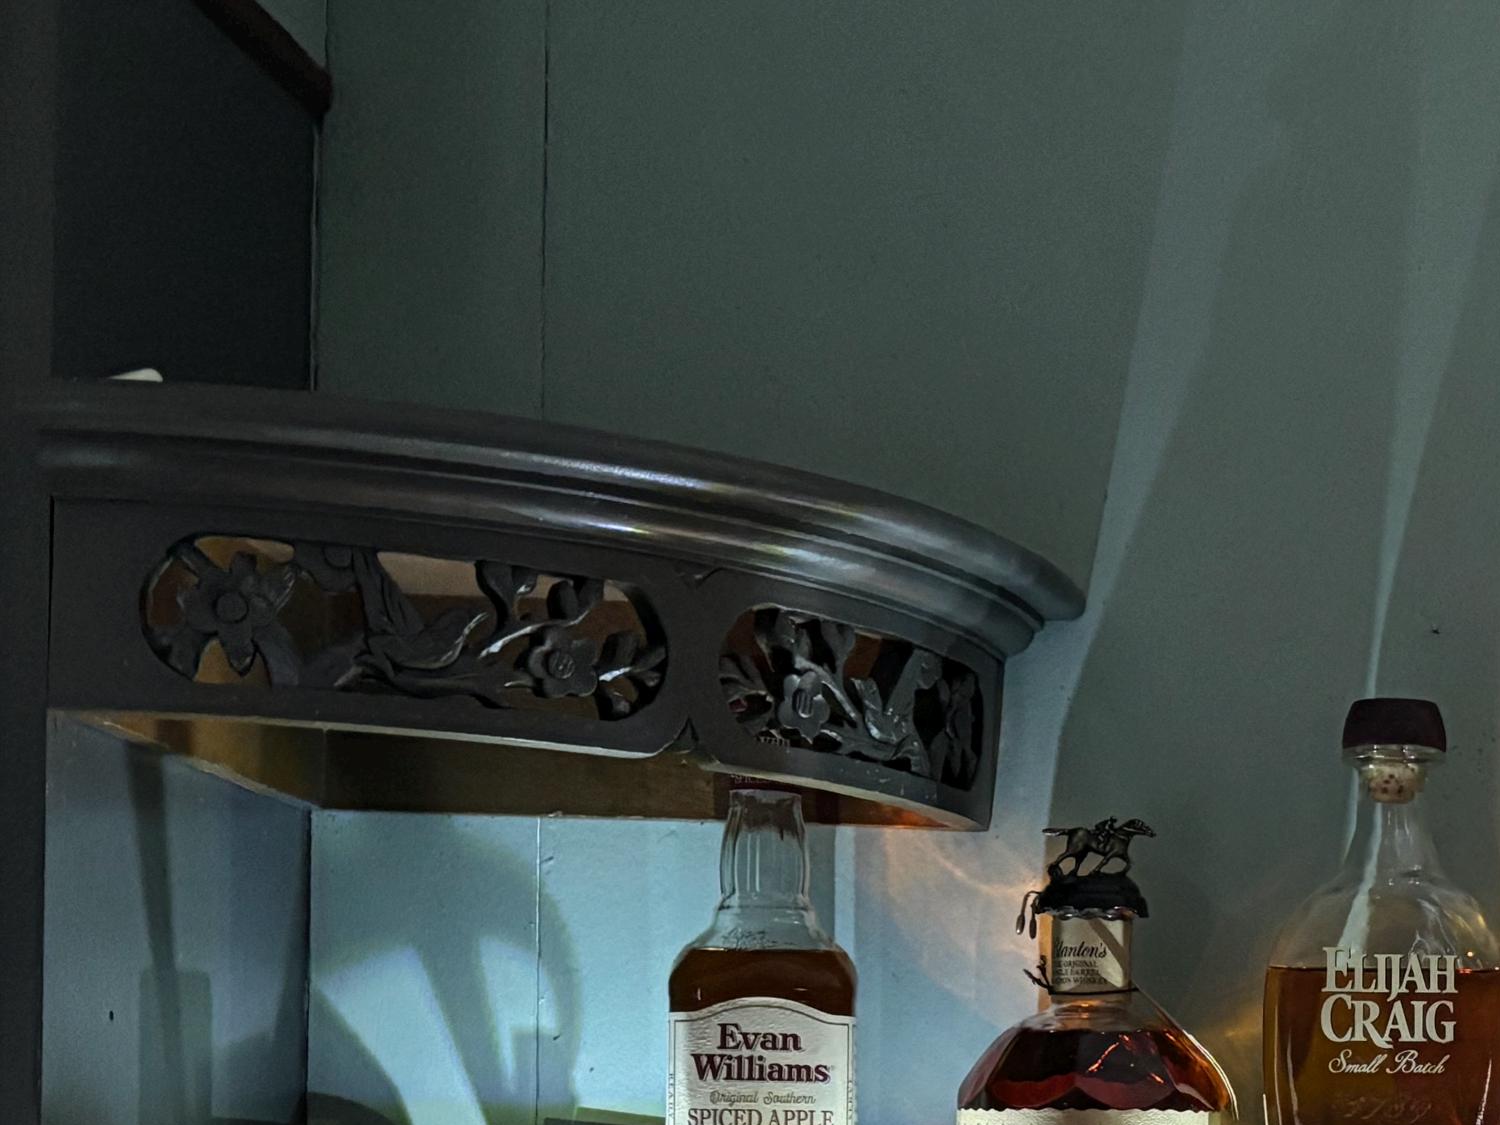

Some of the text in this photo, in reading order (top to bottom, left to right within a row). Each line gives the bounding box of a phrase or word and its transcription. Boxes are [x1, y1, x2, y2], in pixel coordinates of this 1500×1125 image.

[1321, 946, 1459, 1001] ELIJAH
[1320, 993, 1457, 1049] CRAIG
[717, 1023, 803, 1051] Evan
[690, 1053, 831, 1084] Williams
[1328, 1049, 1451, 1075] Small Batch
[710, 1090, 816, 1107] Original Southern
